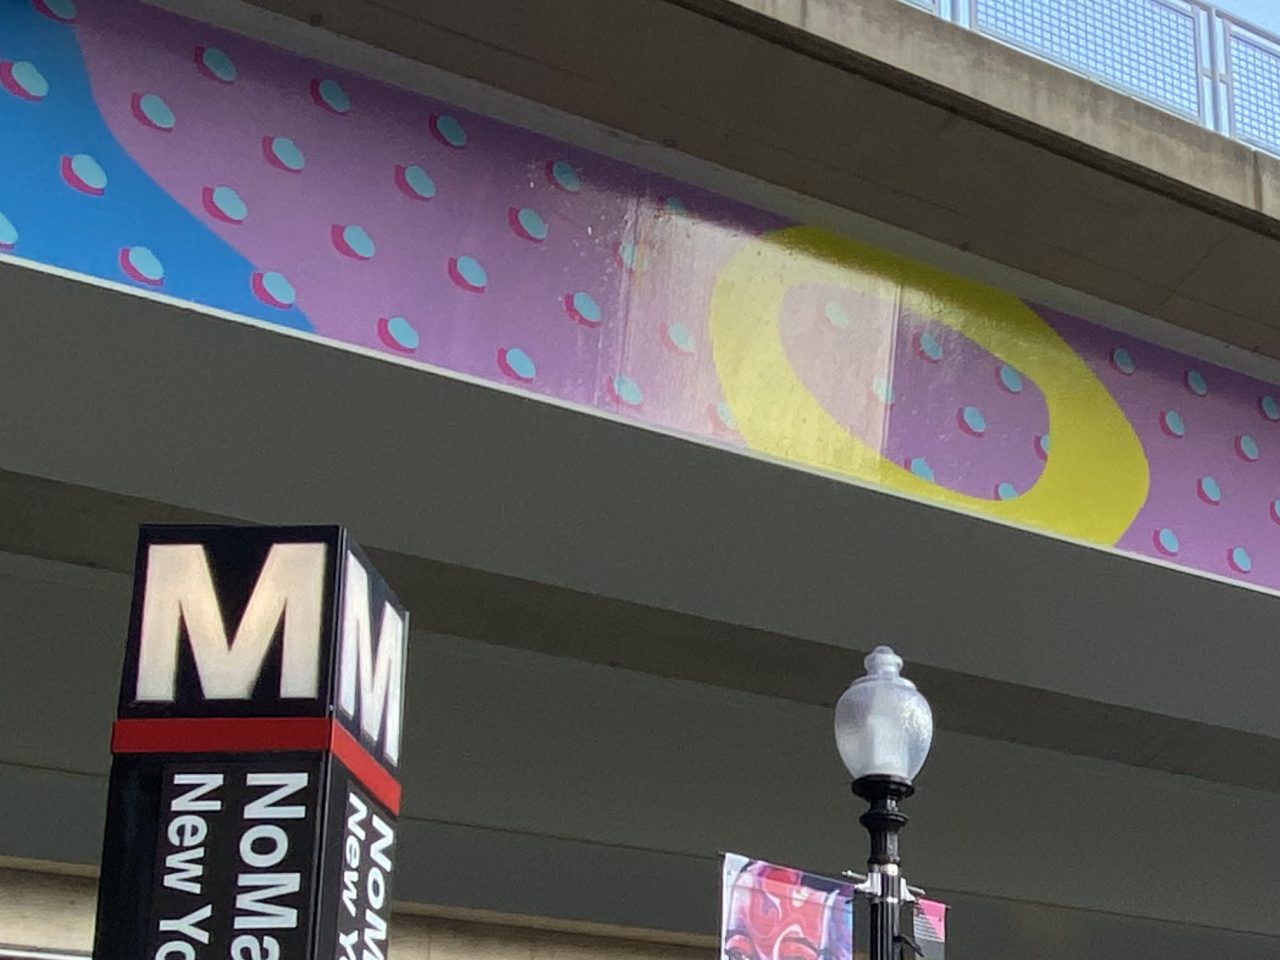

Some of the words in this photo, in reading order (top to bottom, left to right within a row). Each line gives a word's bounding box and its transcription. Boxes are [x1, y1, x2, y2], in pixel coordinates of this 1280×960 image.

[135, 542, 328, 701] M
[338, 549, 402, 768] M
[163, 772, 224, 895] New
[342, 791, 367, 917] New
